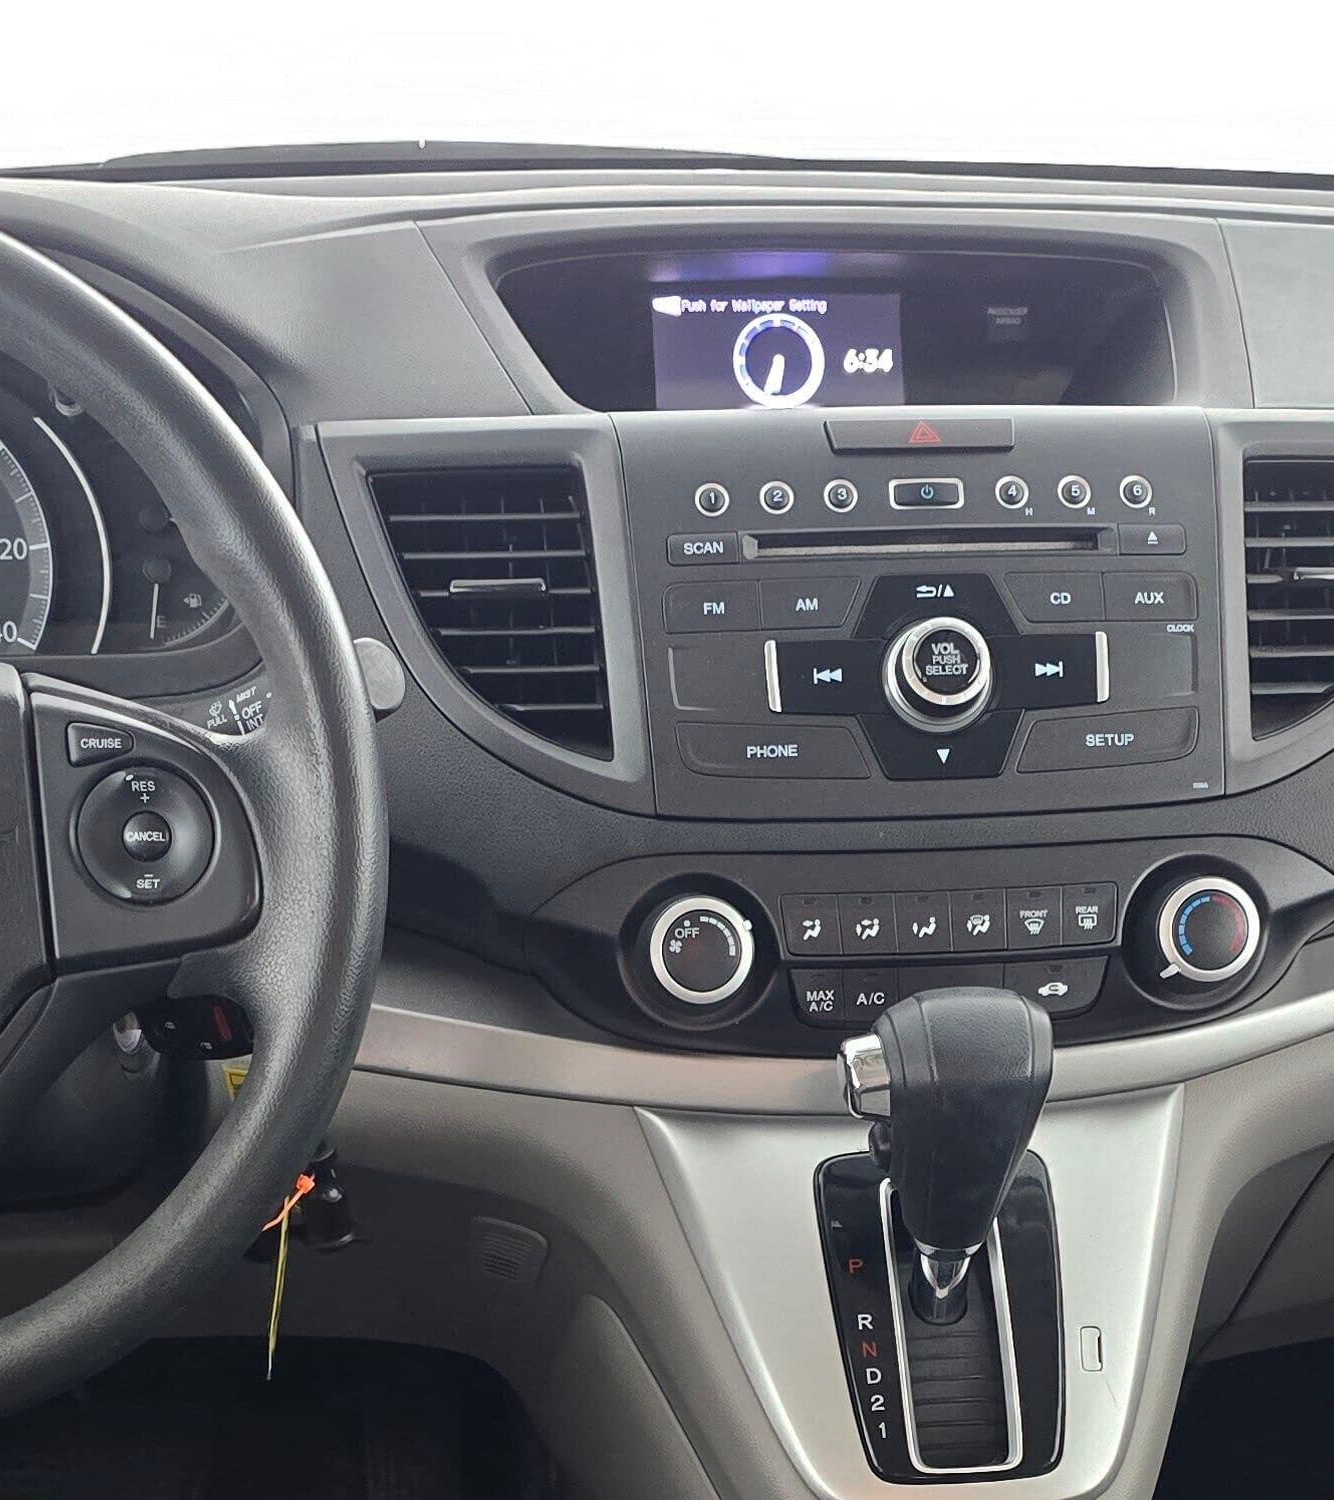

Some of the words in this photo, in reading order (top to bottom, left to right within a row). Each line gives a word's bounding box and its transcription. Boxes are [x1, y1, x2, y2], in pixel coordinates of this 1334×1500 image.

[681, 300, 706, 312] Push
[710, 300, 728, 312] for
[732, 299, 785, 313] Wallpaper
[772, 490, 783, 502] 2
[836, 488, 848, 501] 3
[1007, 486, 1018, 496] 4
[1071, 485, 1080, 496] 5
[1133, 485, 1142, 496] 6
[708, 492, 717, 504] 1
[1025, 508, 1033, 516] H
[1087, 508, 1096, 516] M
[1149, 507, 1156, 515] R
[683, 541, 724, 555] SCAN
[1050, 592, 1071, 605] CD
[1135, 591, 1164, 605] AUX
[703, 602, 725, 615] FM
[795, 598, 819, 612] AM
[1167, 624, 1194, 632] CLOCK
[931, 643, 960, 655] VOL
[932, 654, 961, 665] PUSH
[925, 664, 969, 676] SELECT
[242, 700, 262, 719] OFF
[207, 714, 228, 729] PULL
[246, 714, 263, 731] INT
[80, 738, 122, 749] CRUISE
[1085, 733, 1135, 747] SETUP
[746, 744, 799, 759] PHONE
[131, 780, 156, 792] RES
[126, 831, 166, 842] CANCEL
[136, 879, 161, 890] SET
[1019, 910, 1048, 919] FRONT
[1075, 906, 1099, 914] REAR
[674, 927, 700, 940] OFF
[806, 990, 835, 1002] MAX
[856, 992, 885, 1006] A/C
[808, 1001, 834, 1013] A/C
[848, 1259, 863, 1273] P
[857, 1314, 874, 1330] R
[861, 1343, 877, 1357] N
[866, 1368, 882, 1385] D
[870, 1394, 885, 1411] 2
[878, 1421, 887, 1438] 1
